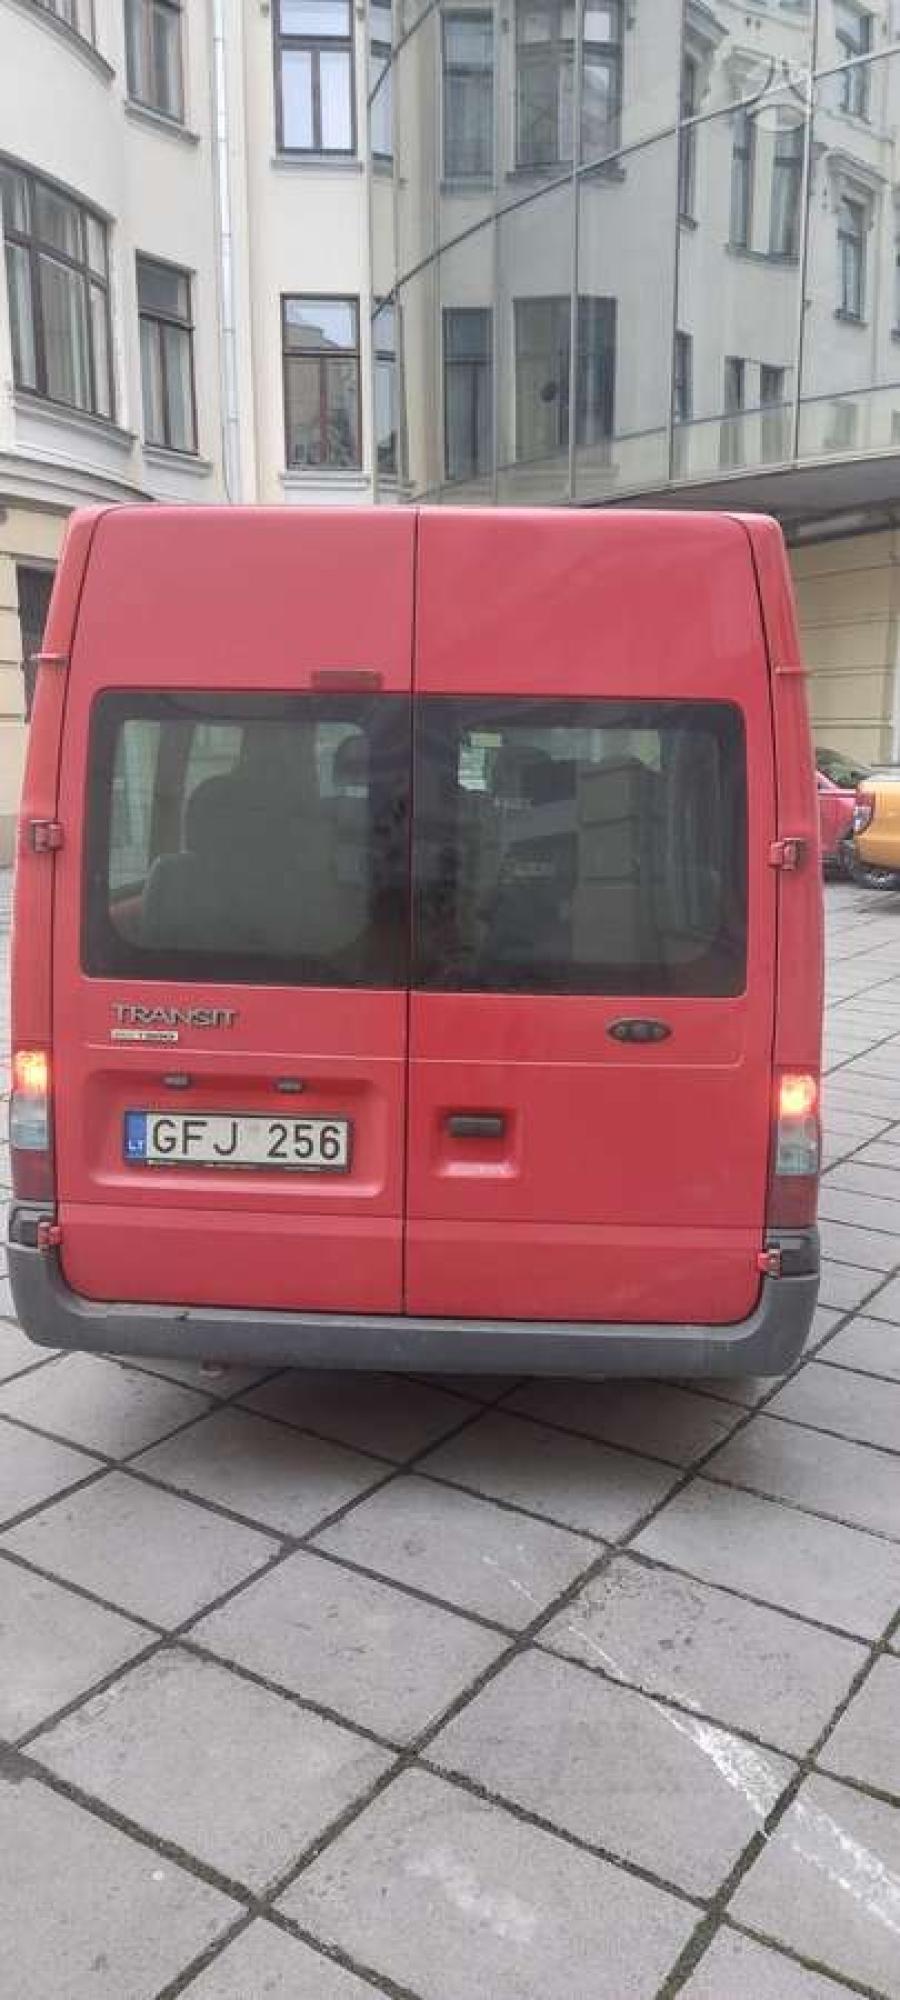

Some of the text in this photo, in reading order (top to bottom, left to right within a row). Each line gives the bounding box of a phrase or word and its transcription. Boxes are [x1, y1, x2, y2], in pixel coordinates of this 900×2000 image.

[111, 1003, 238, 1027] TRANSIT
[128, 1139, 145, 1150] LT
[153, 1119, 341, 1160] GFJ 256
